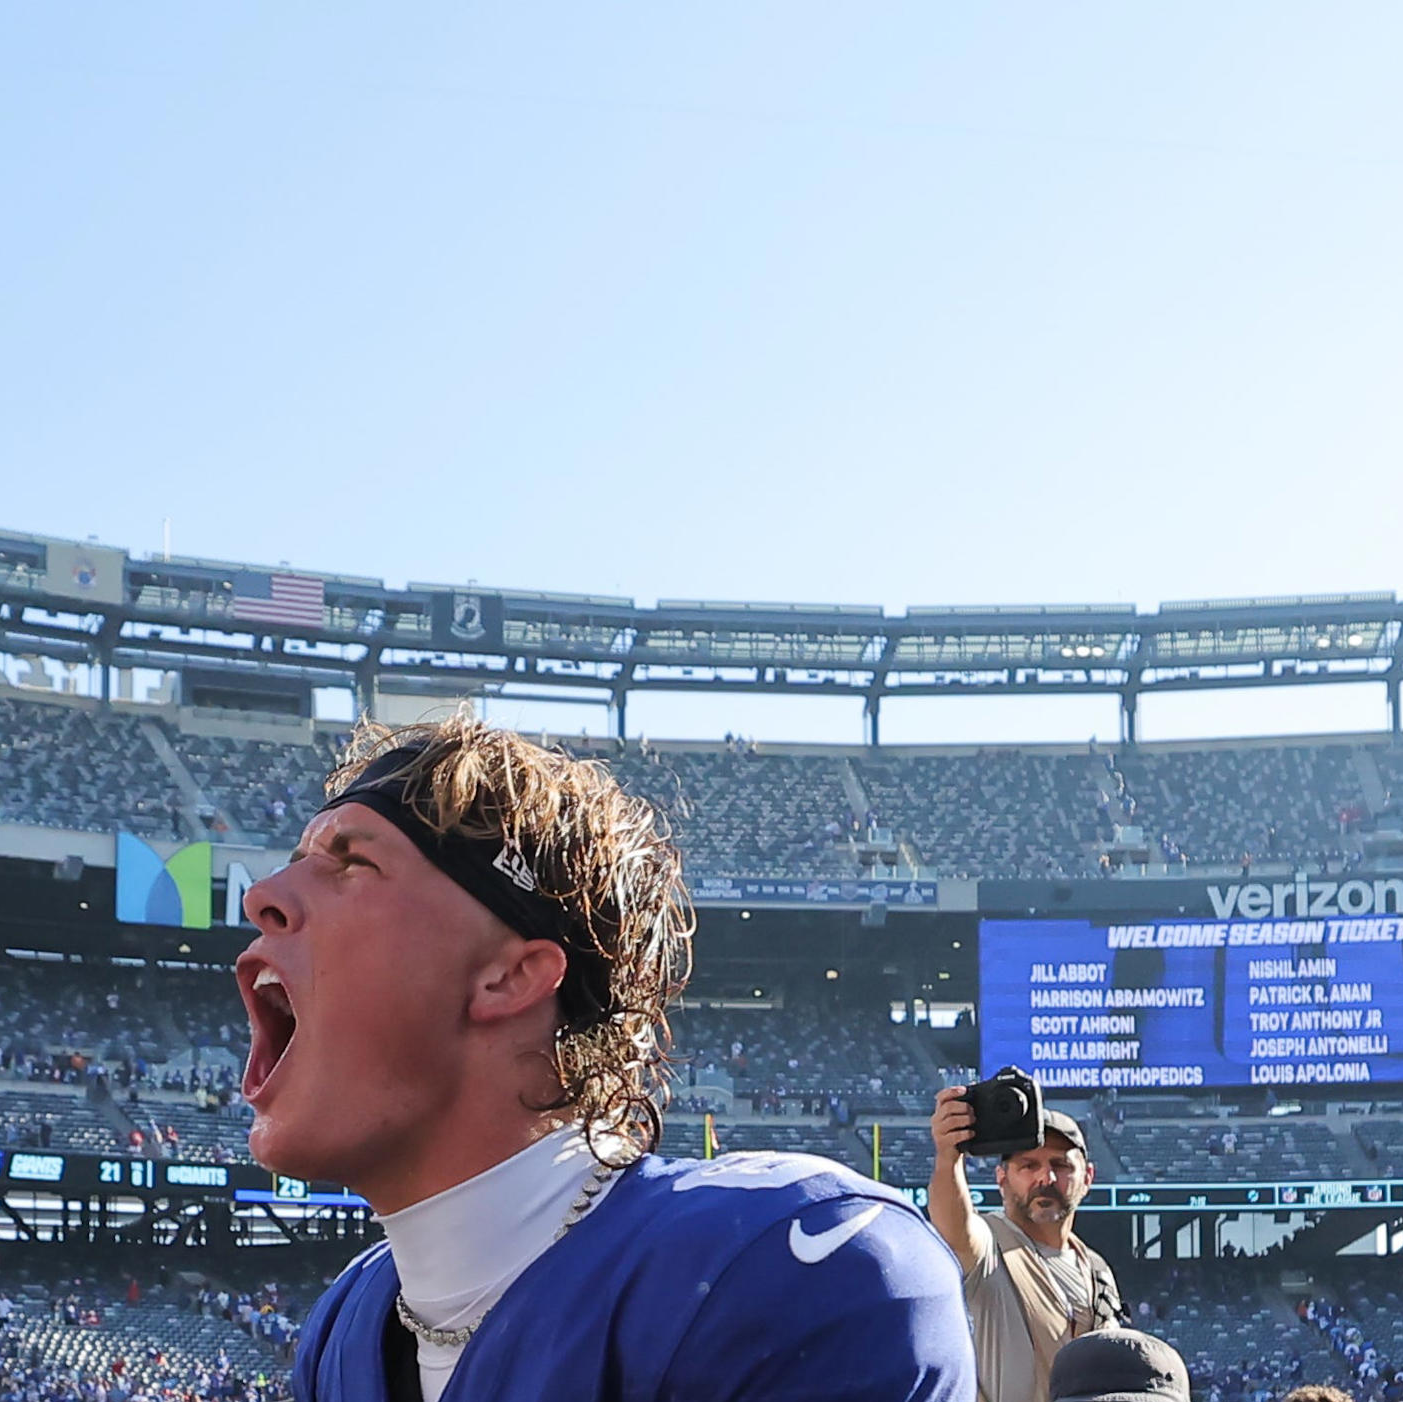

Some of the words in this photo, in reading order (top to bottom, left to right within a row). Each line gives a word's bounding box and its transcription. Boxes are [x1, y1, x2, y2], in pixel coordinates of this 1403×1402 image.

[1108, 924, 1228, 949] WELCOME
[1228, 921, 1325, 946] SEASON
[1030, 964, 1056, 983] JILL
[1058, 964, 1107, 982] ABBOT
[1249, 960, 1295, 979] NISHIL
[1297, 958, 1337, 978] AMIN
[1030, 989, 1103, 1009] HARRISON
[1104, 988, 1205, 1008] ABRAMOWITZ
[1249, 985, 1313, 1005] PATRICK
[1314, 985, 1328, 1003] R.
[1330, 983, 1372, 1002] ANAN
[1030, 1016, 1079, 1035] SCOTT
[1080, 1016, 1135, 1034] AHRONI
[1250, 1012, 1289, 1032] TROY
[1291, 1010, 1363, 1031] ANTHONY
[1365, 1009, 1383, 1028] JR
[1031, 1042, 1069, 1061] DALE
[1070, 1041, 1140, 1060] ALBRIGHT
[1250, 1037, 1305, 1058] JOSEPH
[1307, 1035, 1388, 1056] ANTONELLI
[1032, 1067, 1099, 1087] ALLIANCE
[1101, 1066, 1203, 1086] ORTHOPEDICS
[1251, 1064, 1295, 1084] LOUIS
[1296, 1062, 1371, 1083] APOLONIA
[9, 1153, 64, 1181] GIANTS
[100, 1161, 121, 1182] 21
[167, 1166, 227, 1186] @GIANTS
